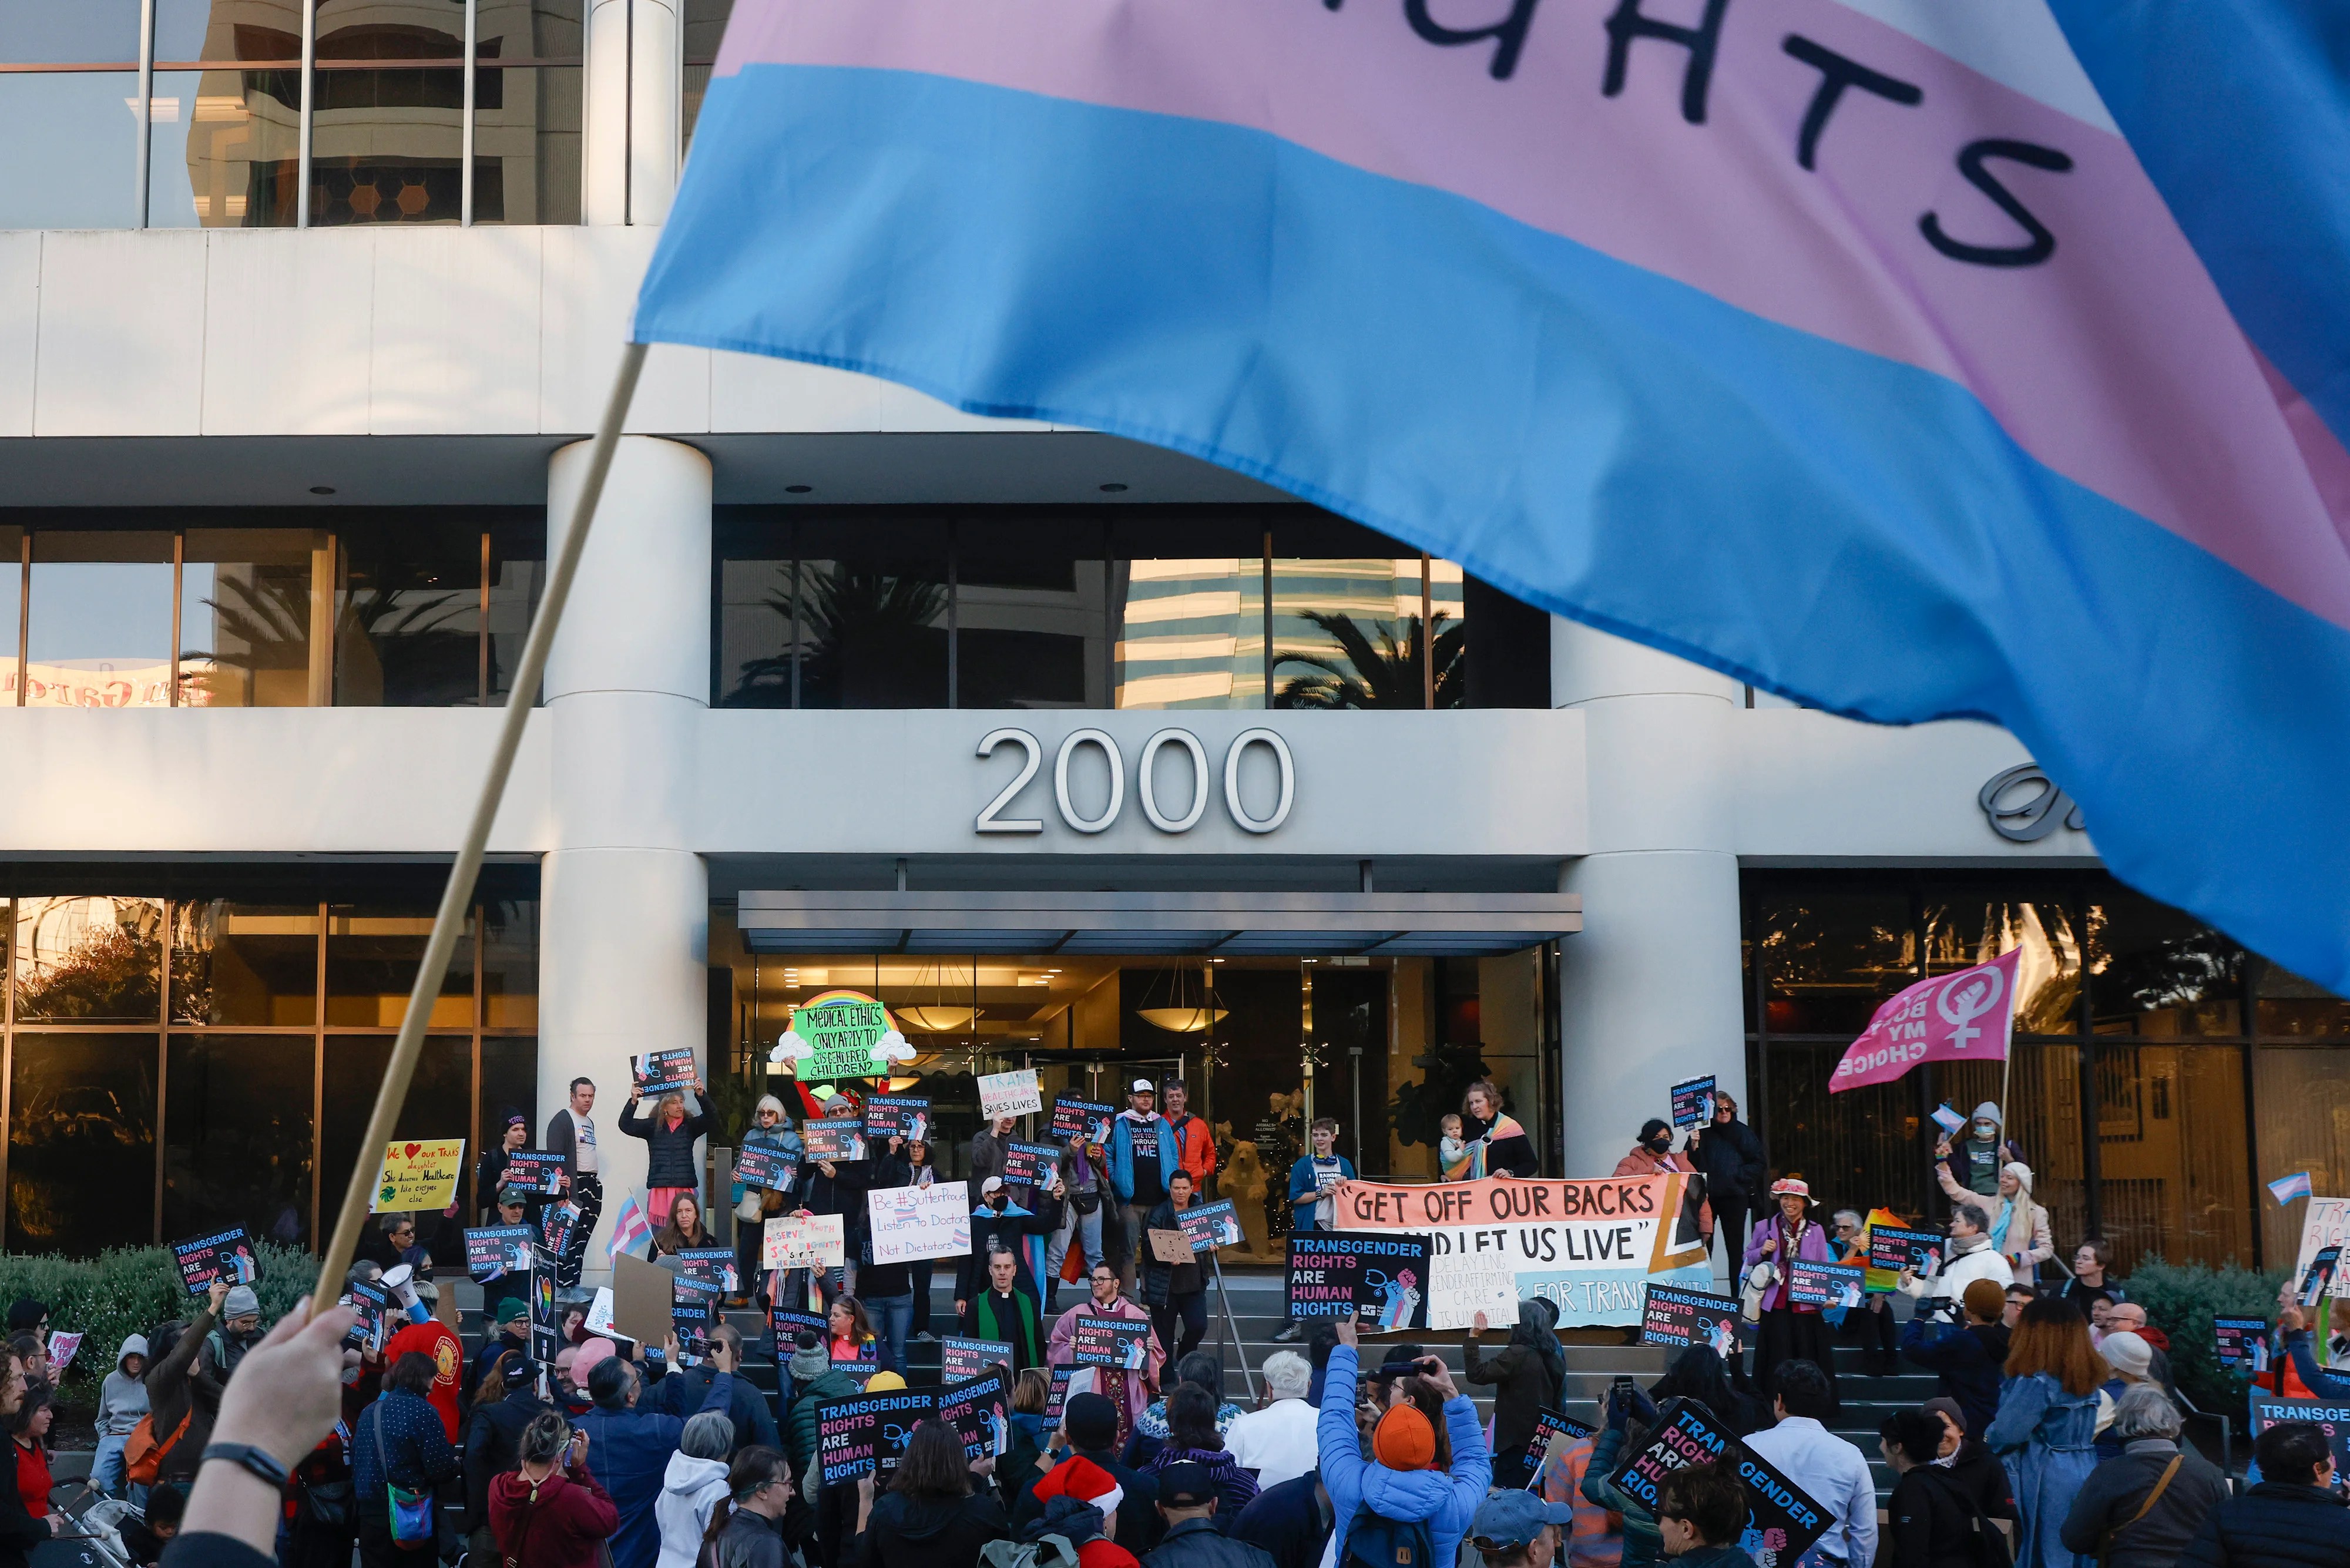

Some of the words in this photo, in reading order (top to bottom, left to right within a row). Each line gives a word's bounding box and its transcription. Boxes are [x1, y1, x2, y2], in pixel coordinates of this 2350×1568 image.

[1323, 0, 2075, 268] GHTS
[975, 727, 1295, 834] 2000
[851, 1006, 882, 1027] ETHICS
[813, 1032, 838, 1050] ONLY
[838, 1030, 863, 1047] APPLY
[864, 1029, 877, 1046] TO
[662, 1050, 691, 1060] RIGHTS
[664, 1058, 692, 1067] HUMAN
[678, 1065, 693, 1073] ARE
[811, 1062, 872, 1076] CHILDREN?
[644, 1079, 694, 1093] TRANSGENDE
[984, 1072, 1036, 1088] TRANS
[982, 1087, 1035, 1102] HEALTHCARE
[1673, 1080, 1713, 1096] TRANSGENDER
[869, 1097, 927, 1107] TRANSGENDER
[1673, 1093, 1694, 1103] RIGHTS
[985, 1102, 1009, 1114] SAVES
[1013, 1099, 1038, 1110] LIVES
[1055, 1107, 1085, 1116] RIGHTS
[1056, 1099, 1114, 1112] TRANSGENDER
[806, 1120, 862, 1130] TRANSGENDER
[1675, 1113, 1696, 1124] RIGHTS
[1053, 1121, 1082, 1130] HUMAN
[807, 1129, 836, 1137] RIGHTS
[387, 1146, 400, 1160] We
[438, 1147, 459, 1157] TRANS
[511, 1152, 565, 1161] TRANSGENDER
[744, 1144, 795, 1161] TRANSGENDER
[1008, 1151, 1035, 1161] RIGHTS
[1009, 1143, 1059, 1157] TRANSGENDER
[1137, 1145, 1156, 1157] ME
[510, 1160, 539, 1168] RIGHTS
[741, 1159, 755, 1167] ARE
[742, 1152, 769, 1163] RIGHTS
[407, 1160, 436, 1171] daughter
[740, 1166, 765, 1176] HUMAN
[1006, 1167, 1032, 1176] HUMAN
[383, 1170, 396, 1183] She
[423, 1169, 454, 1180] Healthcare
[1004, 1176, 1032, 1184] RIGHTS
[415, 1185, 437, 1194] everyone
[874, 1195, 891, 1210] Be
[896, 1187, 966, 1207] #SutterProud
[1424, 1191, 1471, 1222] OFF
[1490, 1186, 1551, 1217] OUR
[1565, 1184, 1654, 1216] BACKS
[1179, 1204, 1231, 1220] TRANSGENDER
[877, 1218, 910, 1231] Listen
[917, 1217, 926, 1227] to
[932, 1214, 969, 1225] Doctors
[1181, 1217, 1207, 1229] RIGHTS
[468, 1228, 528, 1238] TRANSGENDER
[766, 1229, 805, 1243] DESERVE
[1873, 1228, 1942, 1243] TRANSGENDER
[176, 1228, 244, 1255] TRANSGENDER
[469, 1238, 500, 1247] RIGHTS
[559, 1228, 570, 1256] RIGHTS
[880, 1244, 899, 1256] Not
[906, 1238, 952, 1253] Dictators
[1520, 1227, 1556, 1262] US
[1872, 1236, 1907, 1247] RIGHTS
[770, 1244, 789, 1258] JOY
[798, 1240, 840, 1250] DIGNITY
[1292, 1240, 1422, 1257] TRANSGENDER
[179, 1248, 214, 1265] RIGHTS
[471, 1254, 501, 1262] HUMAN
[680, 1251, 733, 1260] TRANSGENDER
[1292, 1255, 1357, 1268] RIGHTS
[1872, 1252, 1905, 1262] HUMAN
[183, 1261, 202, 1275] ARE
[472, 1261, 503, 1270] RIGHTS
[1435, 1253, 1506, 1273] DELAYING
[1793, 1262, 1861, 1277] TRANSGENDER
[1872, 1259, 1906, 1268] RIGHTS
[186, 1267, 219, 1284] HUMAN
[1292, 1271, 1325, 1283] ARE
[1792, 1277, 1811, 1285] ARE
[1793, 1270, 1828, 1280] RIGHTS
[354, 1282, 385, 1304] TRANSGENDER
[1292, 1287, 1352, 1300] HUMAN
[1792, 1285, 1826, 1294] HUMAN
[1454, 1288, 1492, 1305] CARE
[1580, 1280, 1647, 1313] TRANS
[1650, 1289, 1738, 1313] TRANSGENDER
[1792, 1292, 1827, 1301] RIGHTS
[1292, 1302, 1354, 1315] RIGHTS
[1649, 1300, 1694, 1316] RIGHTS
[774, 1312, 827, 1329] TRANSGENDER
[1439, 1311, 1452, 1328] IS
[1456, 1308, 1515, 1325] UNHICAL
[1647, 1311, 1671, 1322] ARE
[538, 1325, 548, 1334] CHOOSE
[1079, 1319, 1147, 1332] TRANSGENDER
[1646, 1321, 1689, 1336] HUMAN
[777, 1332, 793, 1341] ARE
[1079, 1327, 1113, 1338] RIGHTS
[1645, 1331, 1689, 1347] RIGHTS
[945, 1340, 1009, 1354] TRANSGENDER
[1077, 1336, 1096, 1345] ARE
[946, 1349, 979, 1359] RIGHTS
[1077, 1344, 1111, 1354] HUMAN
[945, 1357, 963, 1365] ARE
[1076, 1353, 1112, 1363] RIGHTS
[1048, 1394, 1061, 1404] ARE
[820, 1395, 931, 1420] TRANSGENDER
[821, 1415, 875, 1435] RIGHTS
[822, 1433, 849, 1451] ARE
[824, 1443, 873, 1466] HUMAN
[825, 1458, 875, 1480] RIGHTS
[1677, 1411, 1818, 1530] TRANGENDER
